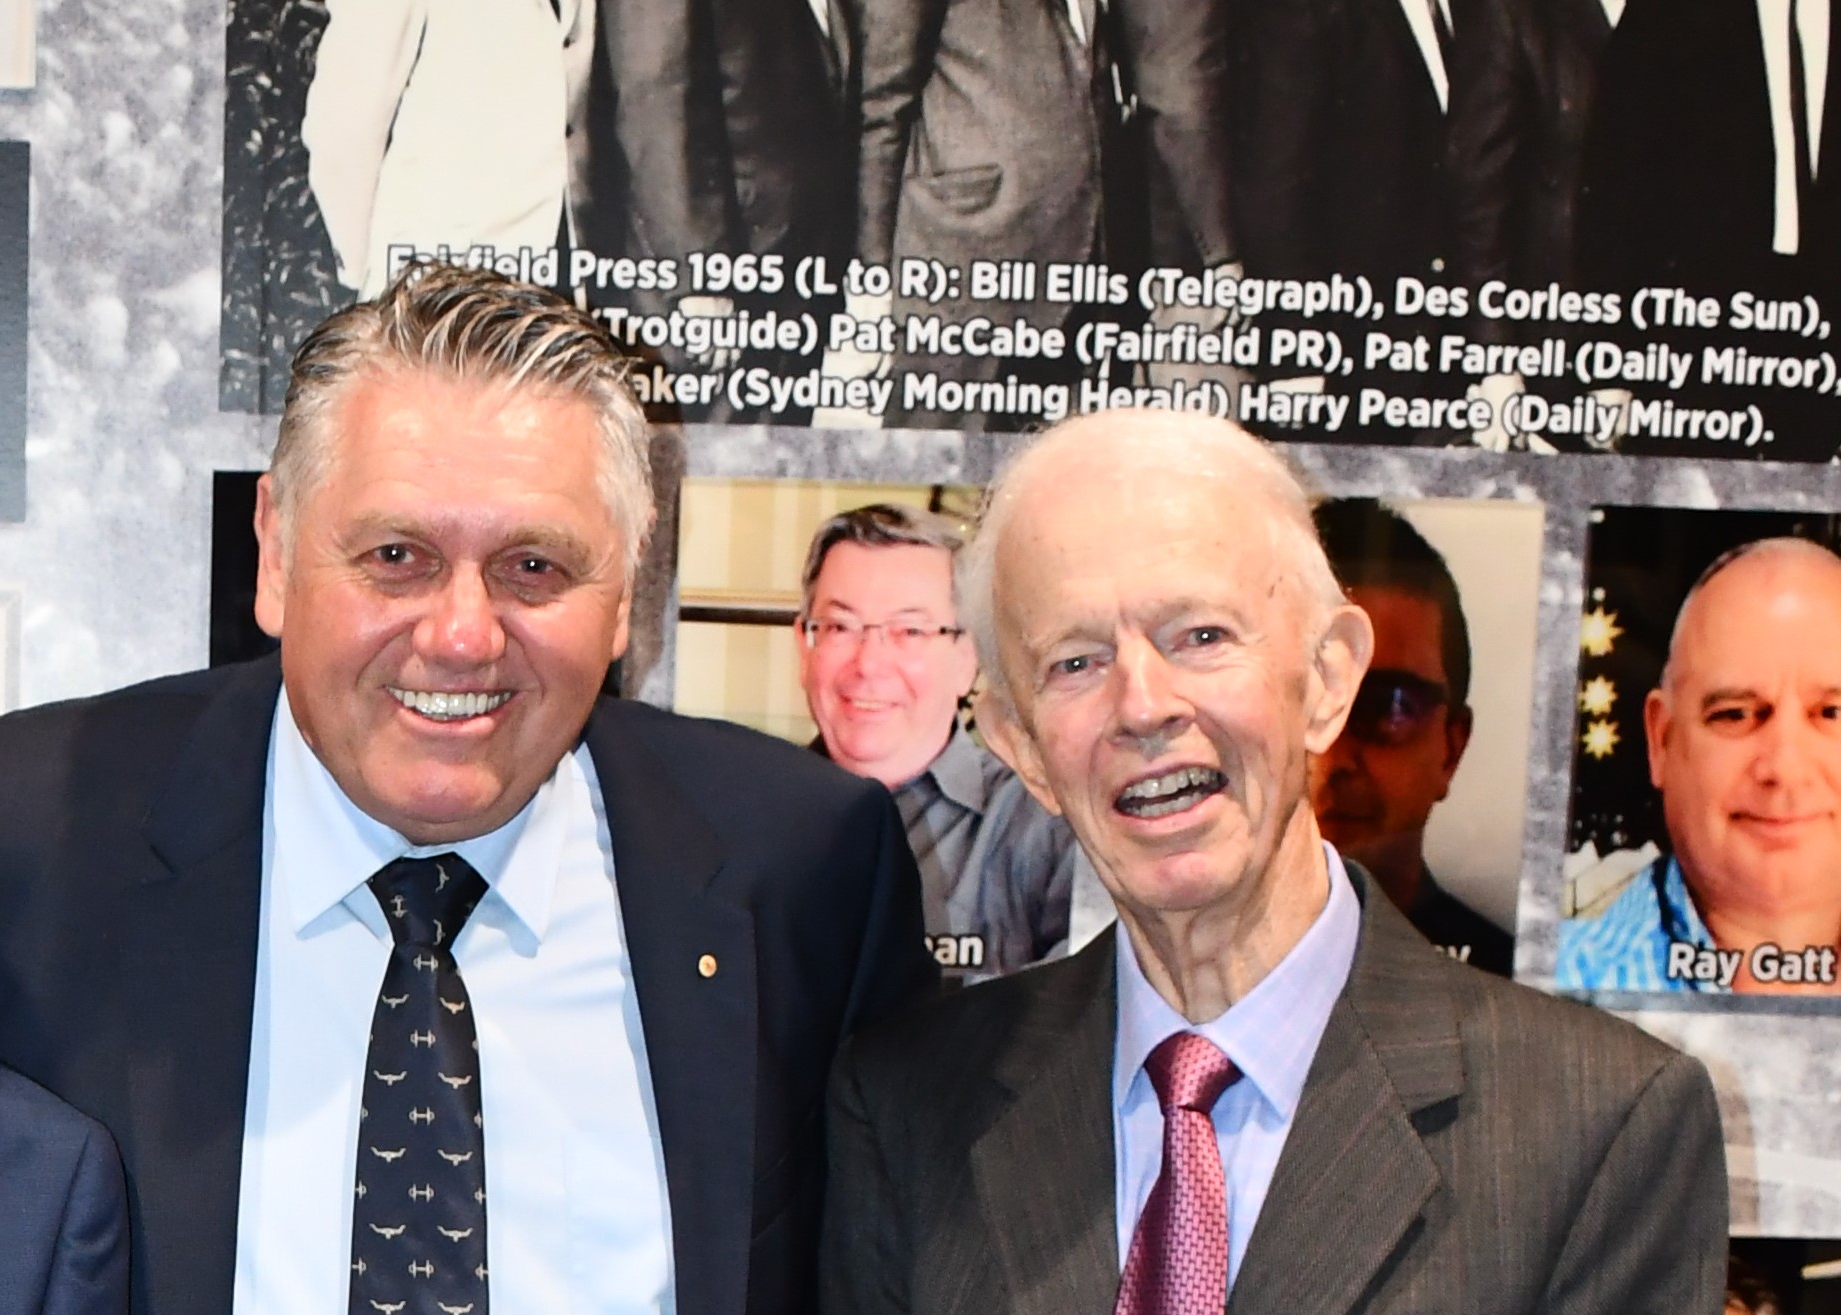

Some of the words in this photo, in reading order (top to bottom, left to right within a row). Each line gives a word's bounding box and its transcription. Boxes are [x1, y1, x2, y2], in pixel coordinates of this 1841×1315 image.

[570, 249, 678, 291] Press
[688, 252, 784, 293] 1965
[794, 255, 838, 299] (L
[847, 258, 891, 296] to
[901, 258, 959, 301] R):
[970, 260, 1035, 300] Bill
[1046, 263, 1129, 304] Ellis
[1138, 268, 1385, 321] (Telegraph),
[1394, 276, 1469, 318] Des
[1478, 280, 1621, 325] Corless
[1630, 287, 1721, 331] (The
[1728, 291, 1831, 340] Sun),
[828, 313, 896, 353] Pat
[906, 315, 1066, 358] McCabe
[1075, 322, 1260, 366] (Fairfield
[1269, 328, 1354, 376] PR),
[1364, 332, 1431, 372] Pat
[1439, 335, 1566, 377] Farrell
[1574, 341, 1694, 389] (Daily
[1700, 346, 1841, 396] Mirror),
[726, 365, 894, 416] (Sydney
[902, 372, 1069, 420] Morning
[1239, 383, 1350, 431] Harry
[1358, 388, 1493, 431] Pearce
[1500, 394, 1622, 442] (Daily
[1629, 399, 1775, 447] Mirror).
[1668, 942, 1743, 985] Ray
[1749, 945, 1836, 982] Gatt
